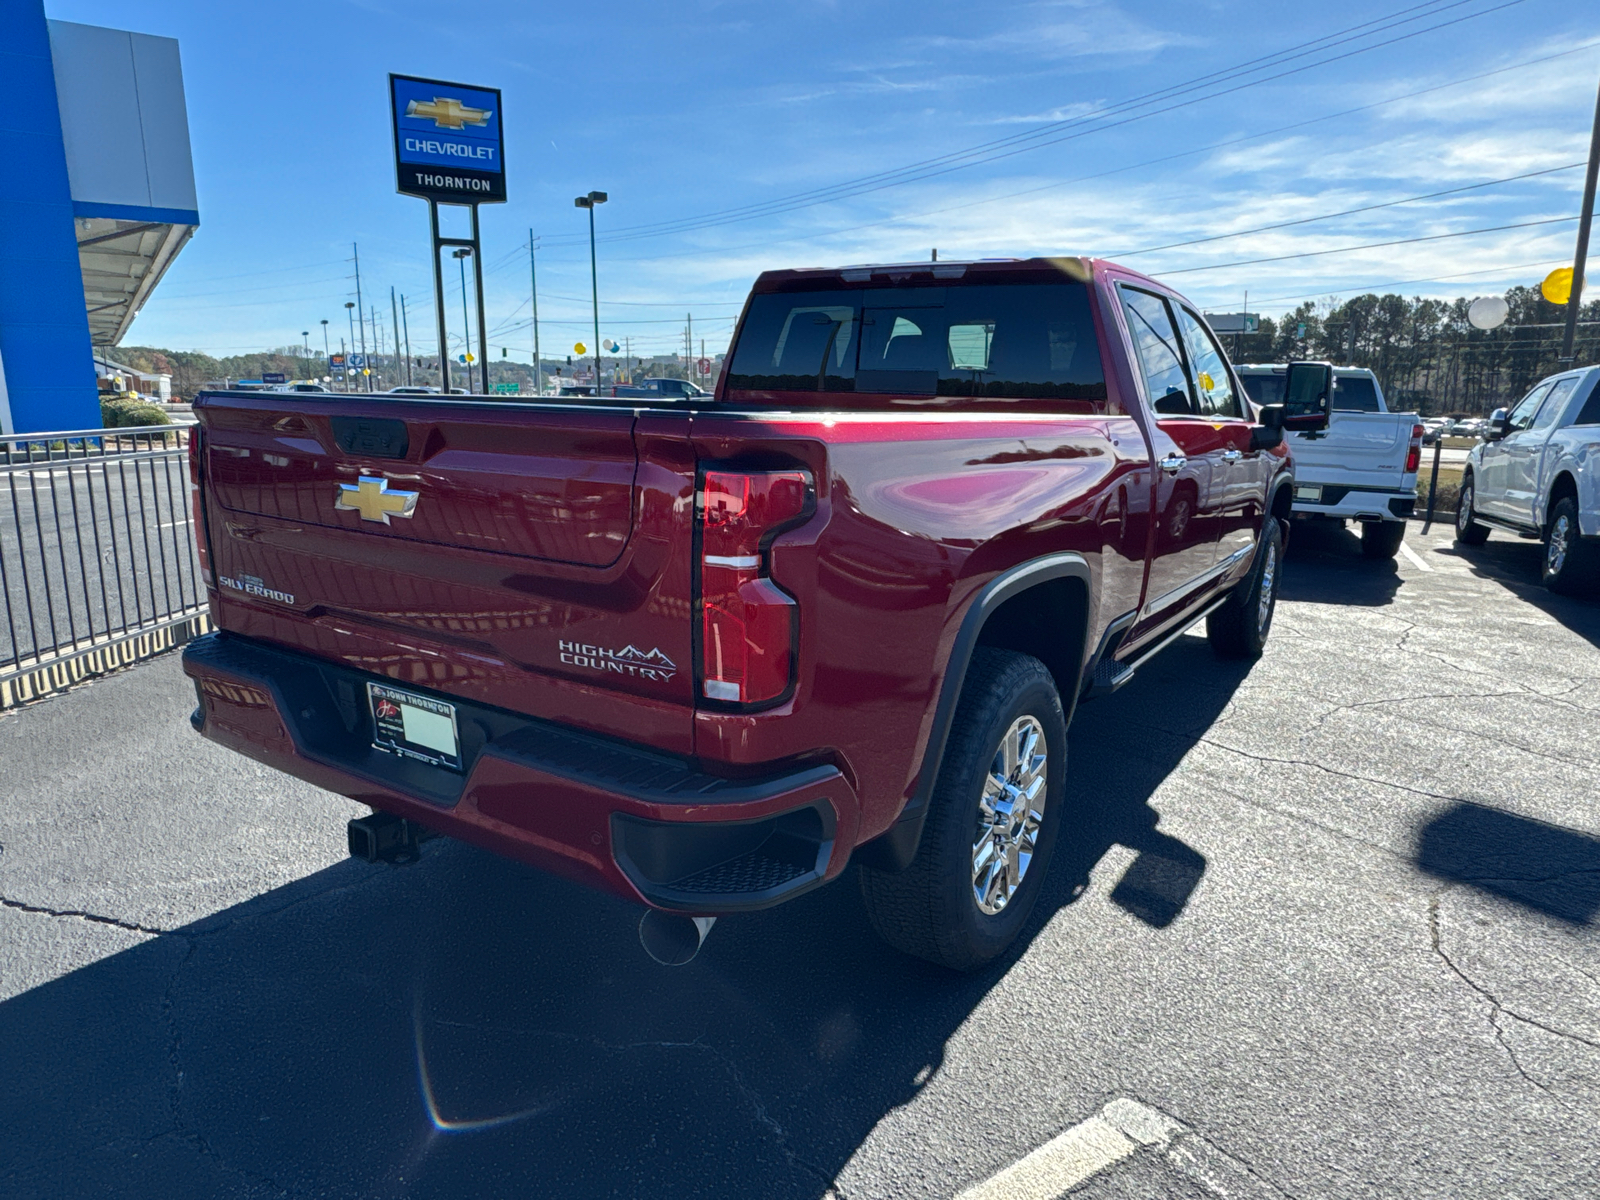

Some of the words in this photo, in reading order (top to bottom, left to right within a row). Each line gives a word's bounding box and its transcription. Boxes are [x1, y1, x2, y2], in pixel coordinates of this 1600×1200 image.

[405, 138, 495, 160] CHEVROLET
[415, 173, 491, 191] THORNTON
[219, 576, 295, 605] SILVERADO
[559, 640, 614, 658] HIGH
[560, 652, 677, 682] COUNTRY
[386, 690, 407, 702] JOHN
[407, 696, 450, 714] THORNTON
